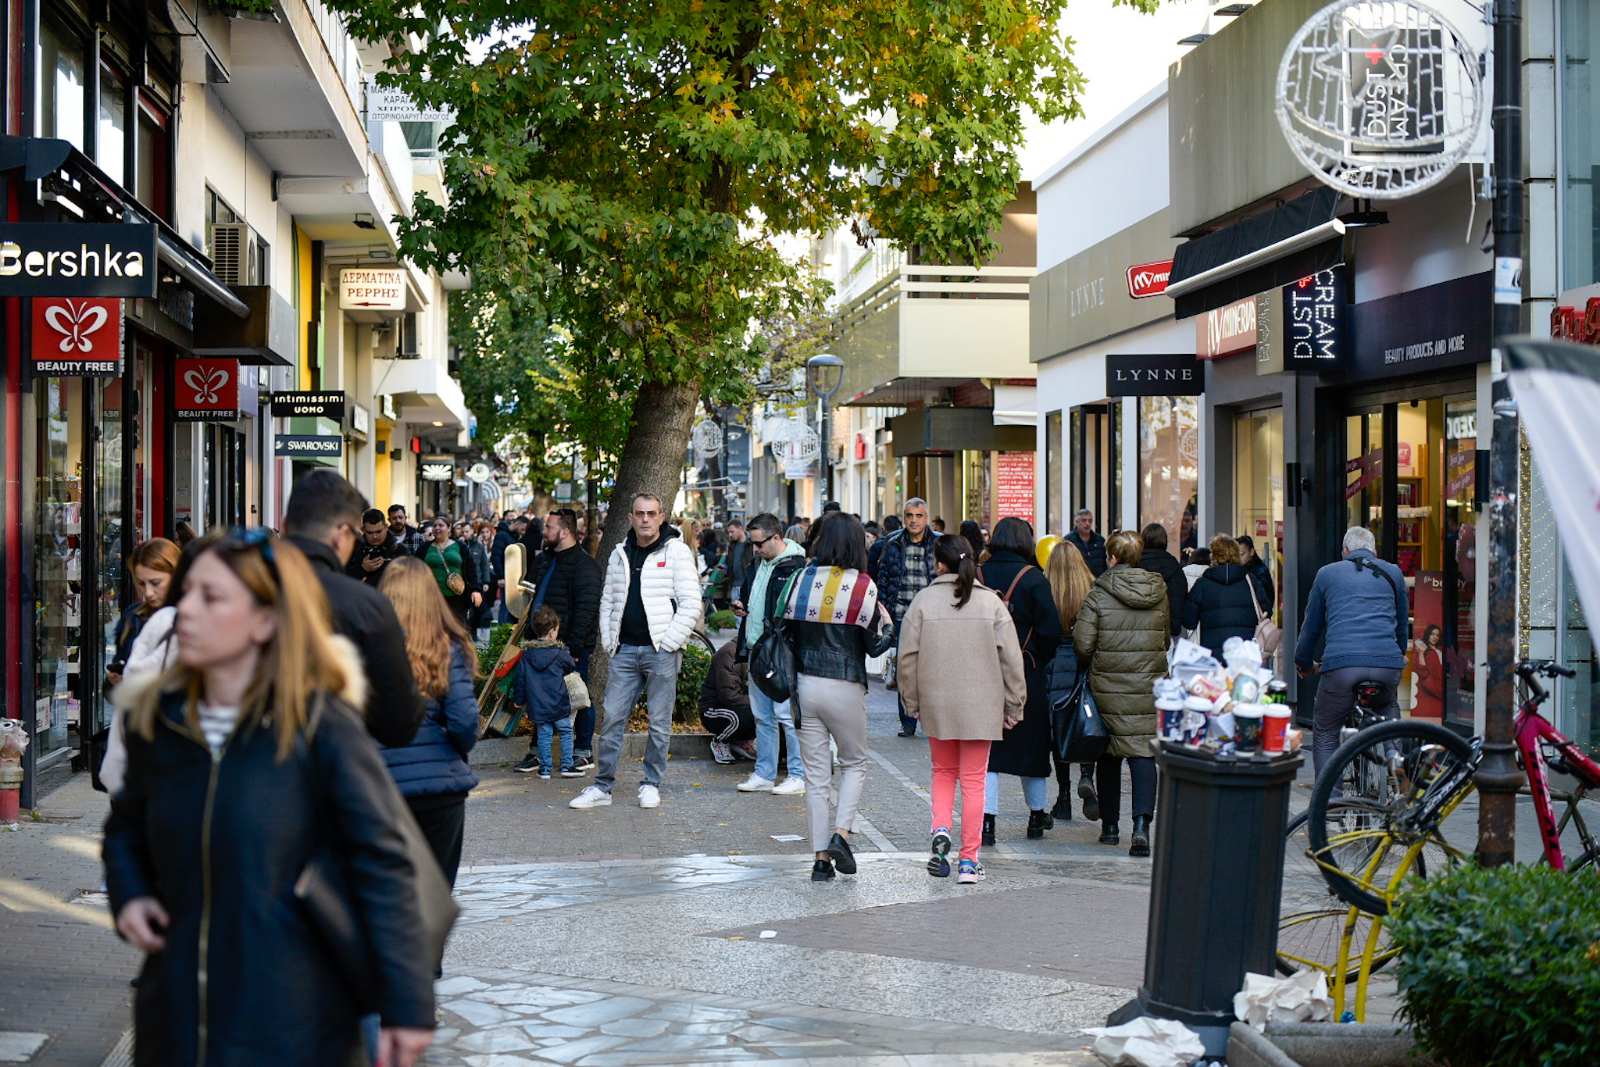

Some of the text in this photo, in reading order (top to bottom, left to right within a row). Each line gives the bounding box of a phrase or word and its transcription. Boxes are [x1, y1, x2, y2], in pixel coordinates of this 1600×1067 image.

[0, 242, 144, 277] Bershka
[342, 272, 401, 284] ΔΕΡΜΑΤΙΝΑ
[1315, 269, 1335, 359] CREAM
[1384, 334, 1465, 364] BEAUTY PRODUCTS AND MORE
[37, 361, 114, 371] BEAUTY FREE
[1117, 369, 1193, 381] LYNNE
[275, 395, 343, 403] intimissimi
[294, 406, 324, 414] UOMO
[287, 440, 339, 451] SWAROVSKI
